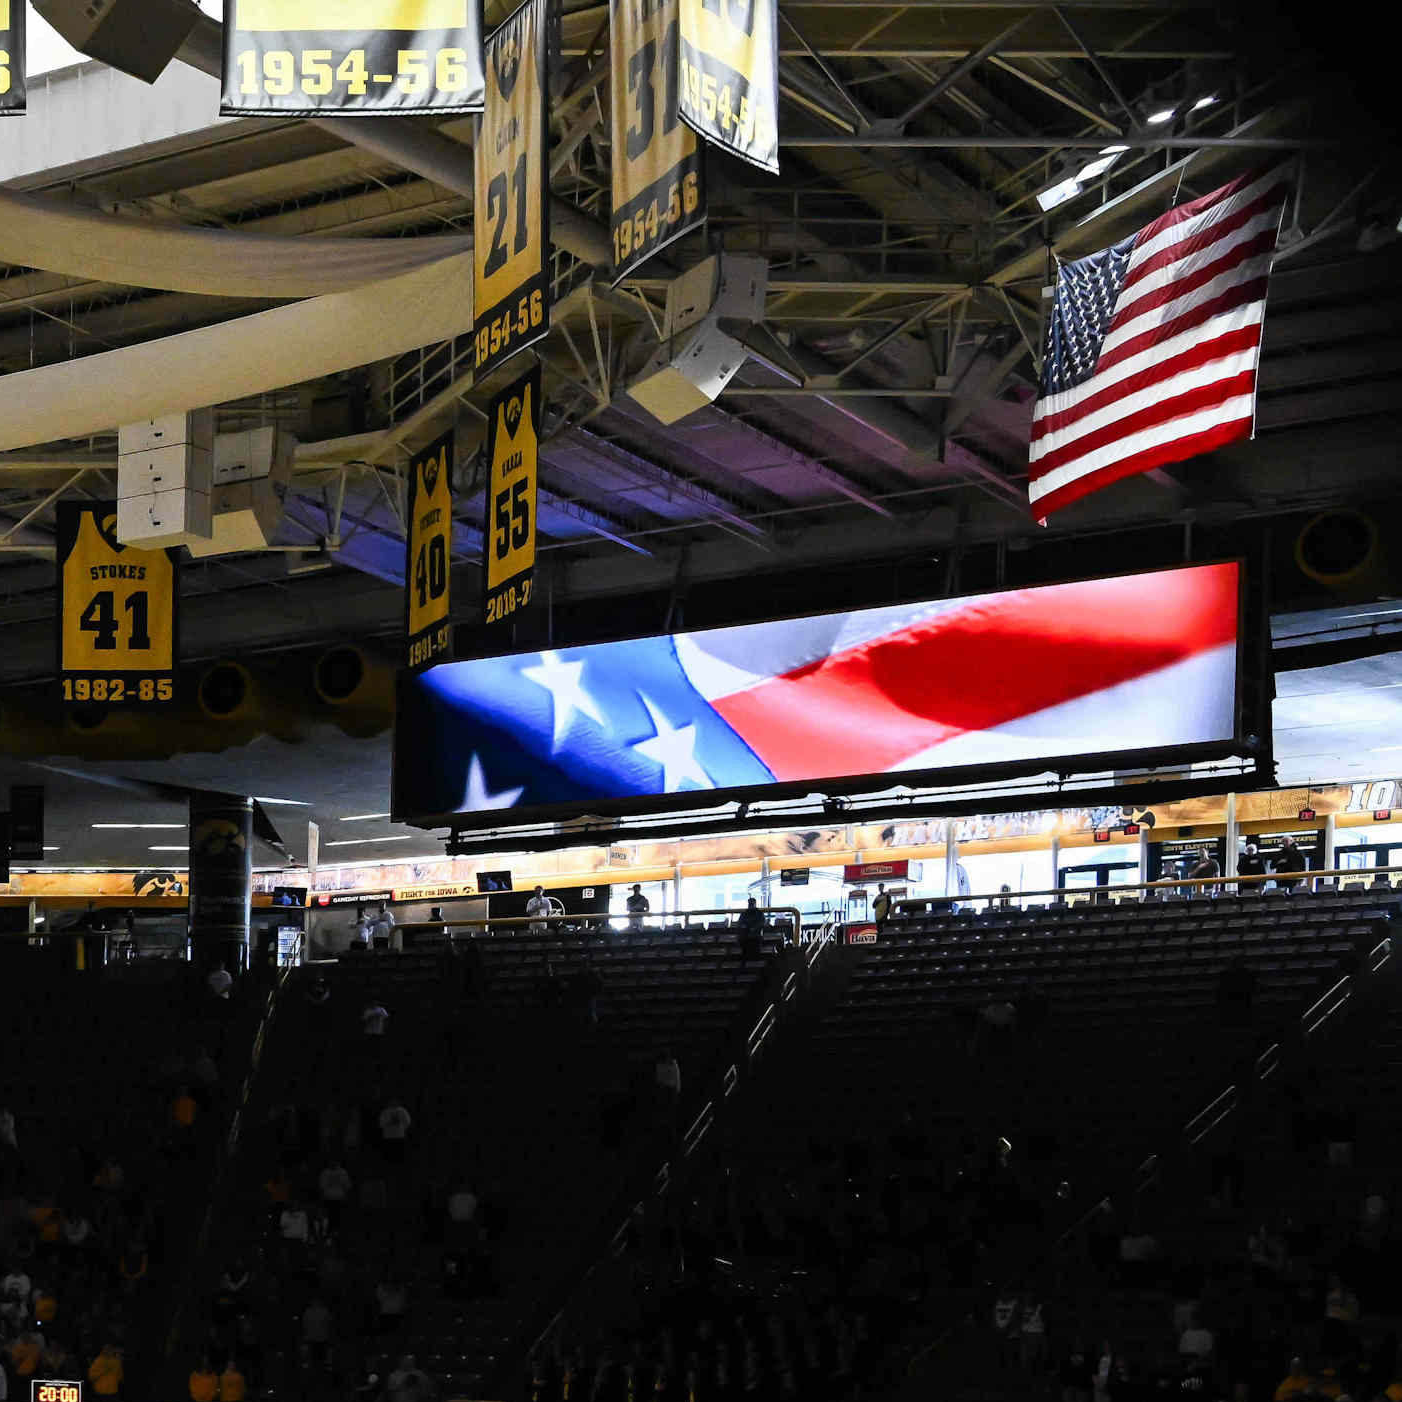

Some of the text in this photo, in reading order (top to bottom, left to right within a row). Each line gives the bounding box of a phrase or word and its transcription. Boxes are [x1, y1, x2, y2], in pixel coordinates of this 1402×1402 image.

[235, 47, 468, 96] 1954-56
[484, 152, 528, 279] 21
[613, 171, 699, 266] 1954-56
[475, 289, 543, 368] 1954-56
[496, 476, 529, 560] 55
[90, 564, 146, 582] STOKES
[416, 534, 445, 608] 40
[80, 591, 151, 650] 41
[62, 678, 173, 701] 1982-85
[437, 887, 458, 896] IOWA
